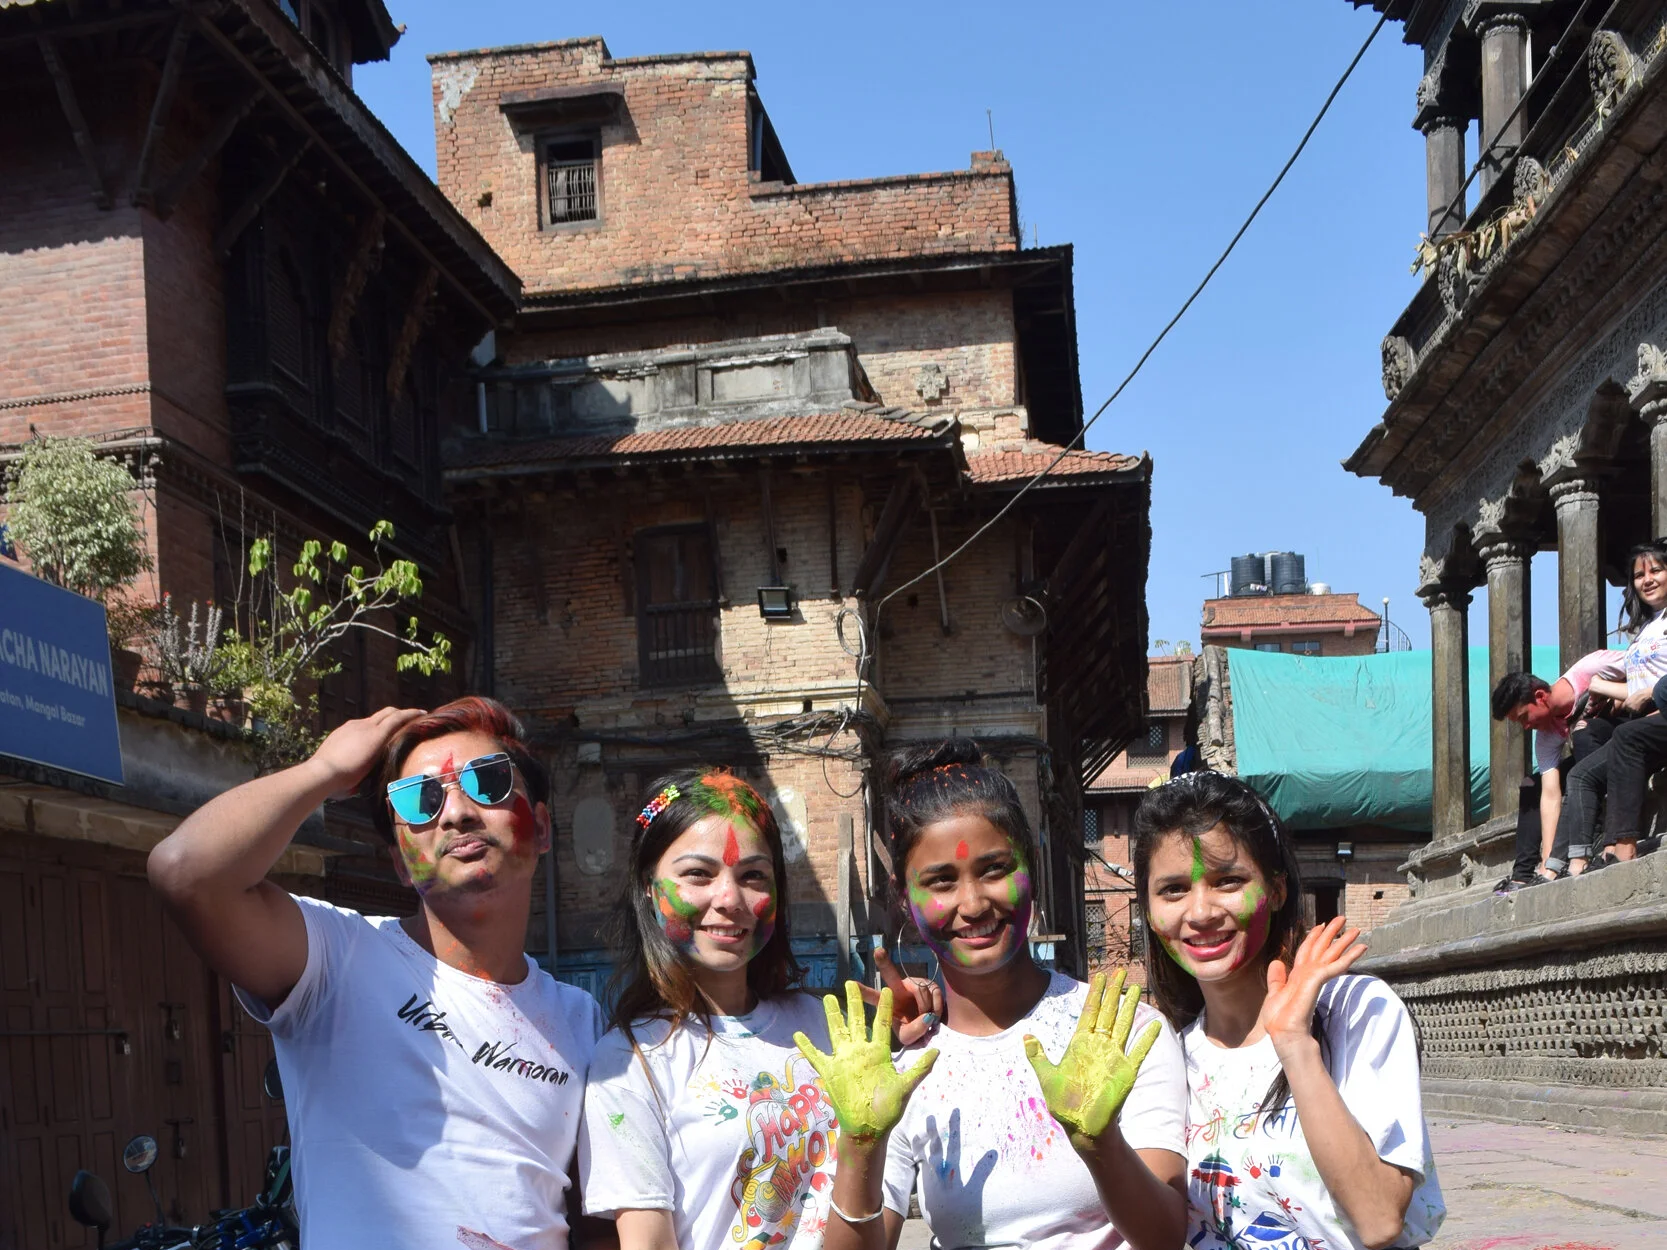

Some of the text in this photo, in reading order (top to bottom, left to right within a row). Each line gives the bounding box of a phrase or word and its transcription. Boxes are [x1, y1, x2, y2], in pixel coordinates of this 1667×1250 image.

[38, 640, 108, 697] NARAYAN
[25, 694, 58, 721] Mangal
[61, 706, 86, 728] Bazar
